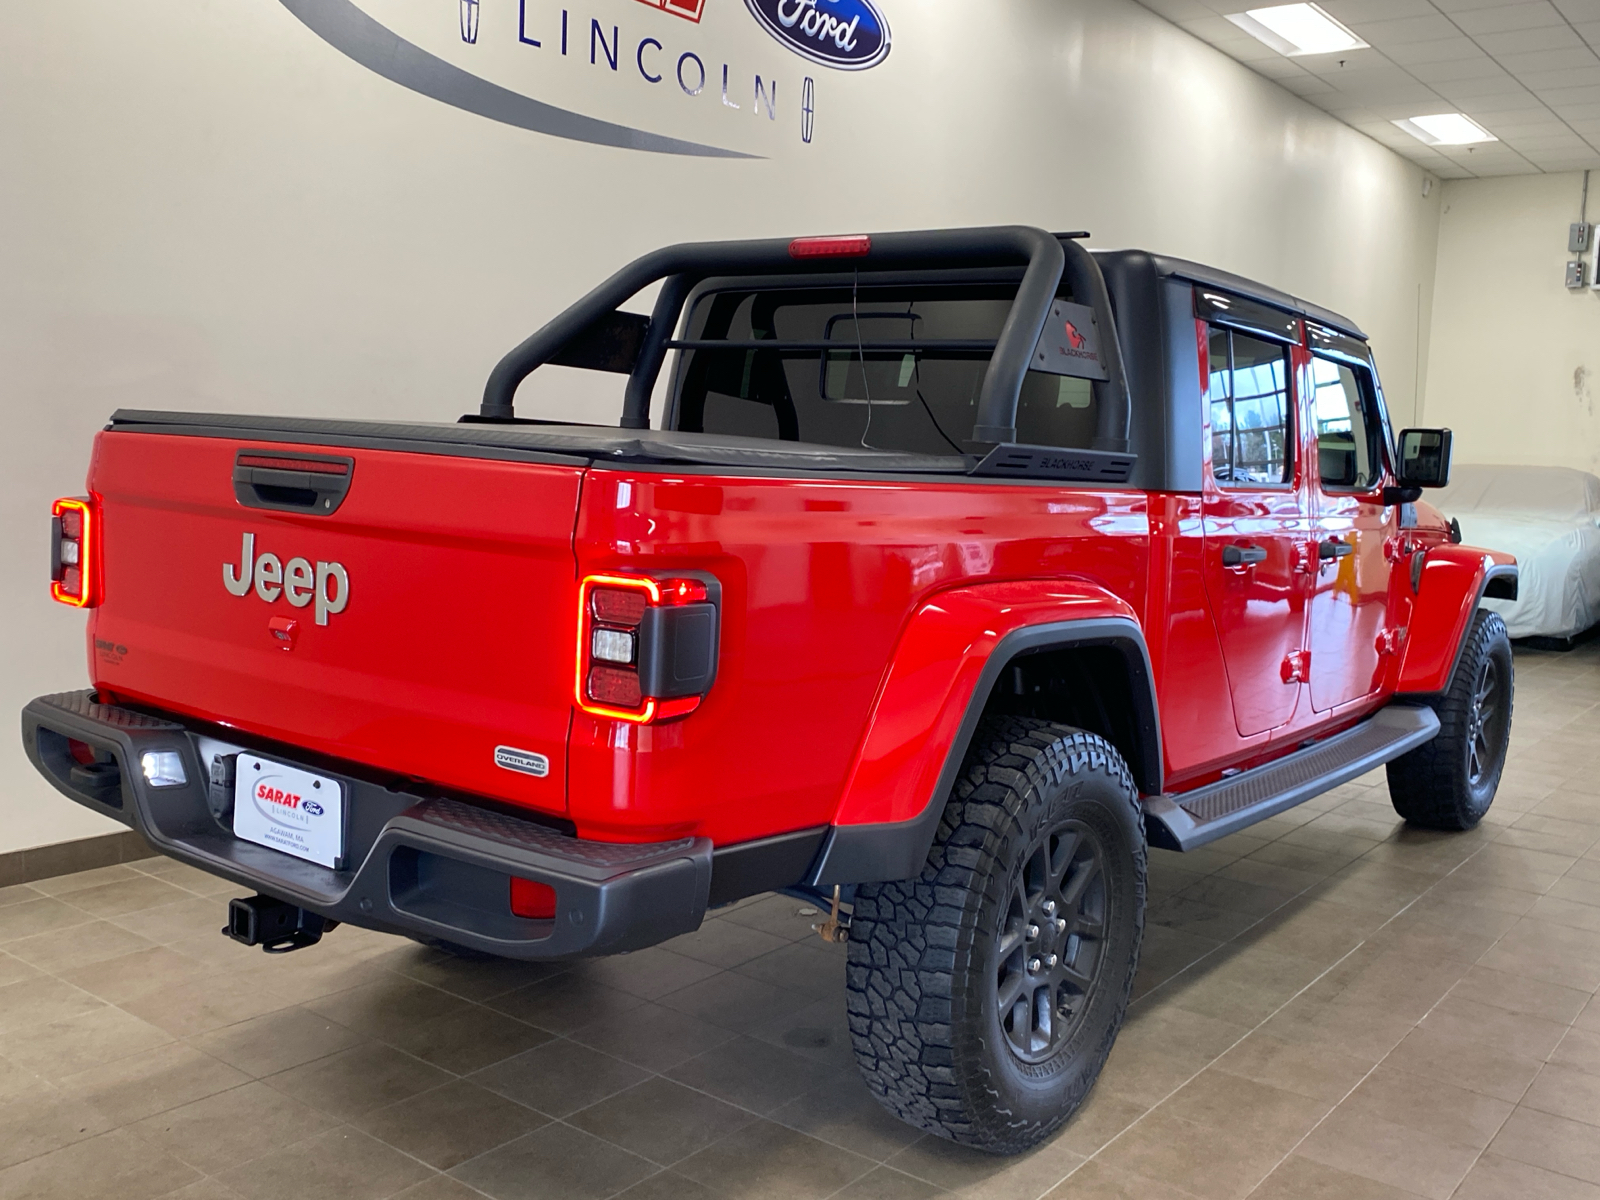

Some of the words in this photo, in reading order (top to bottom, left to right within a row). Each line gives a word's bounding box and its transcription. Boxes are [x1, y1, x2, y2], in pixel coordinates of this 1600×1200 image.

[518, 0, 777, 121] LINCOLN
[1040, 457, 1095, 471] BLACKHORSE
[223, 532, 349, 626] Jeep
[496, 753, 546, 770] OVERLAND
[257, 784, 302, 809] SARAT
[276, 807, 304, 821] LINCOLN
